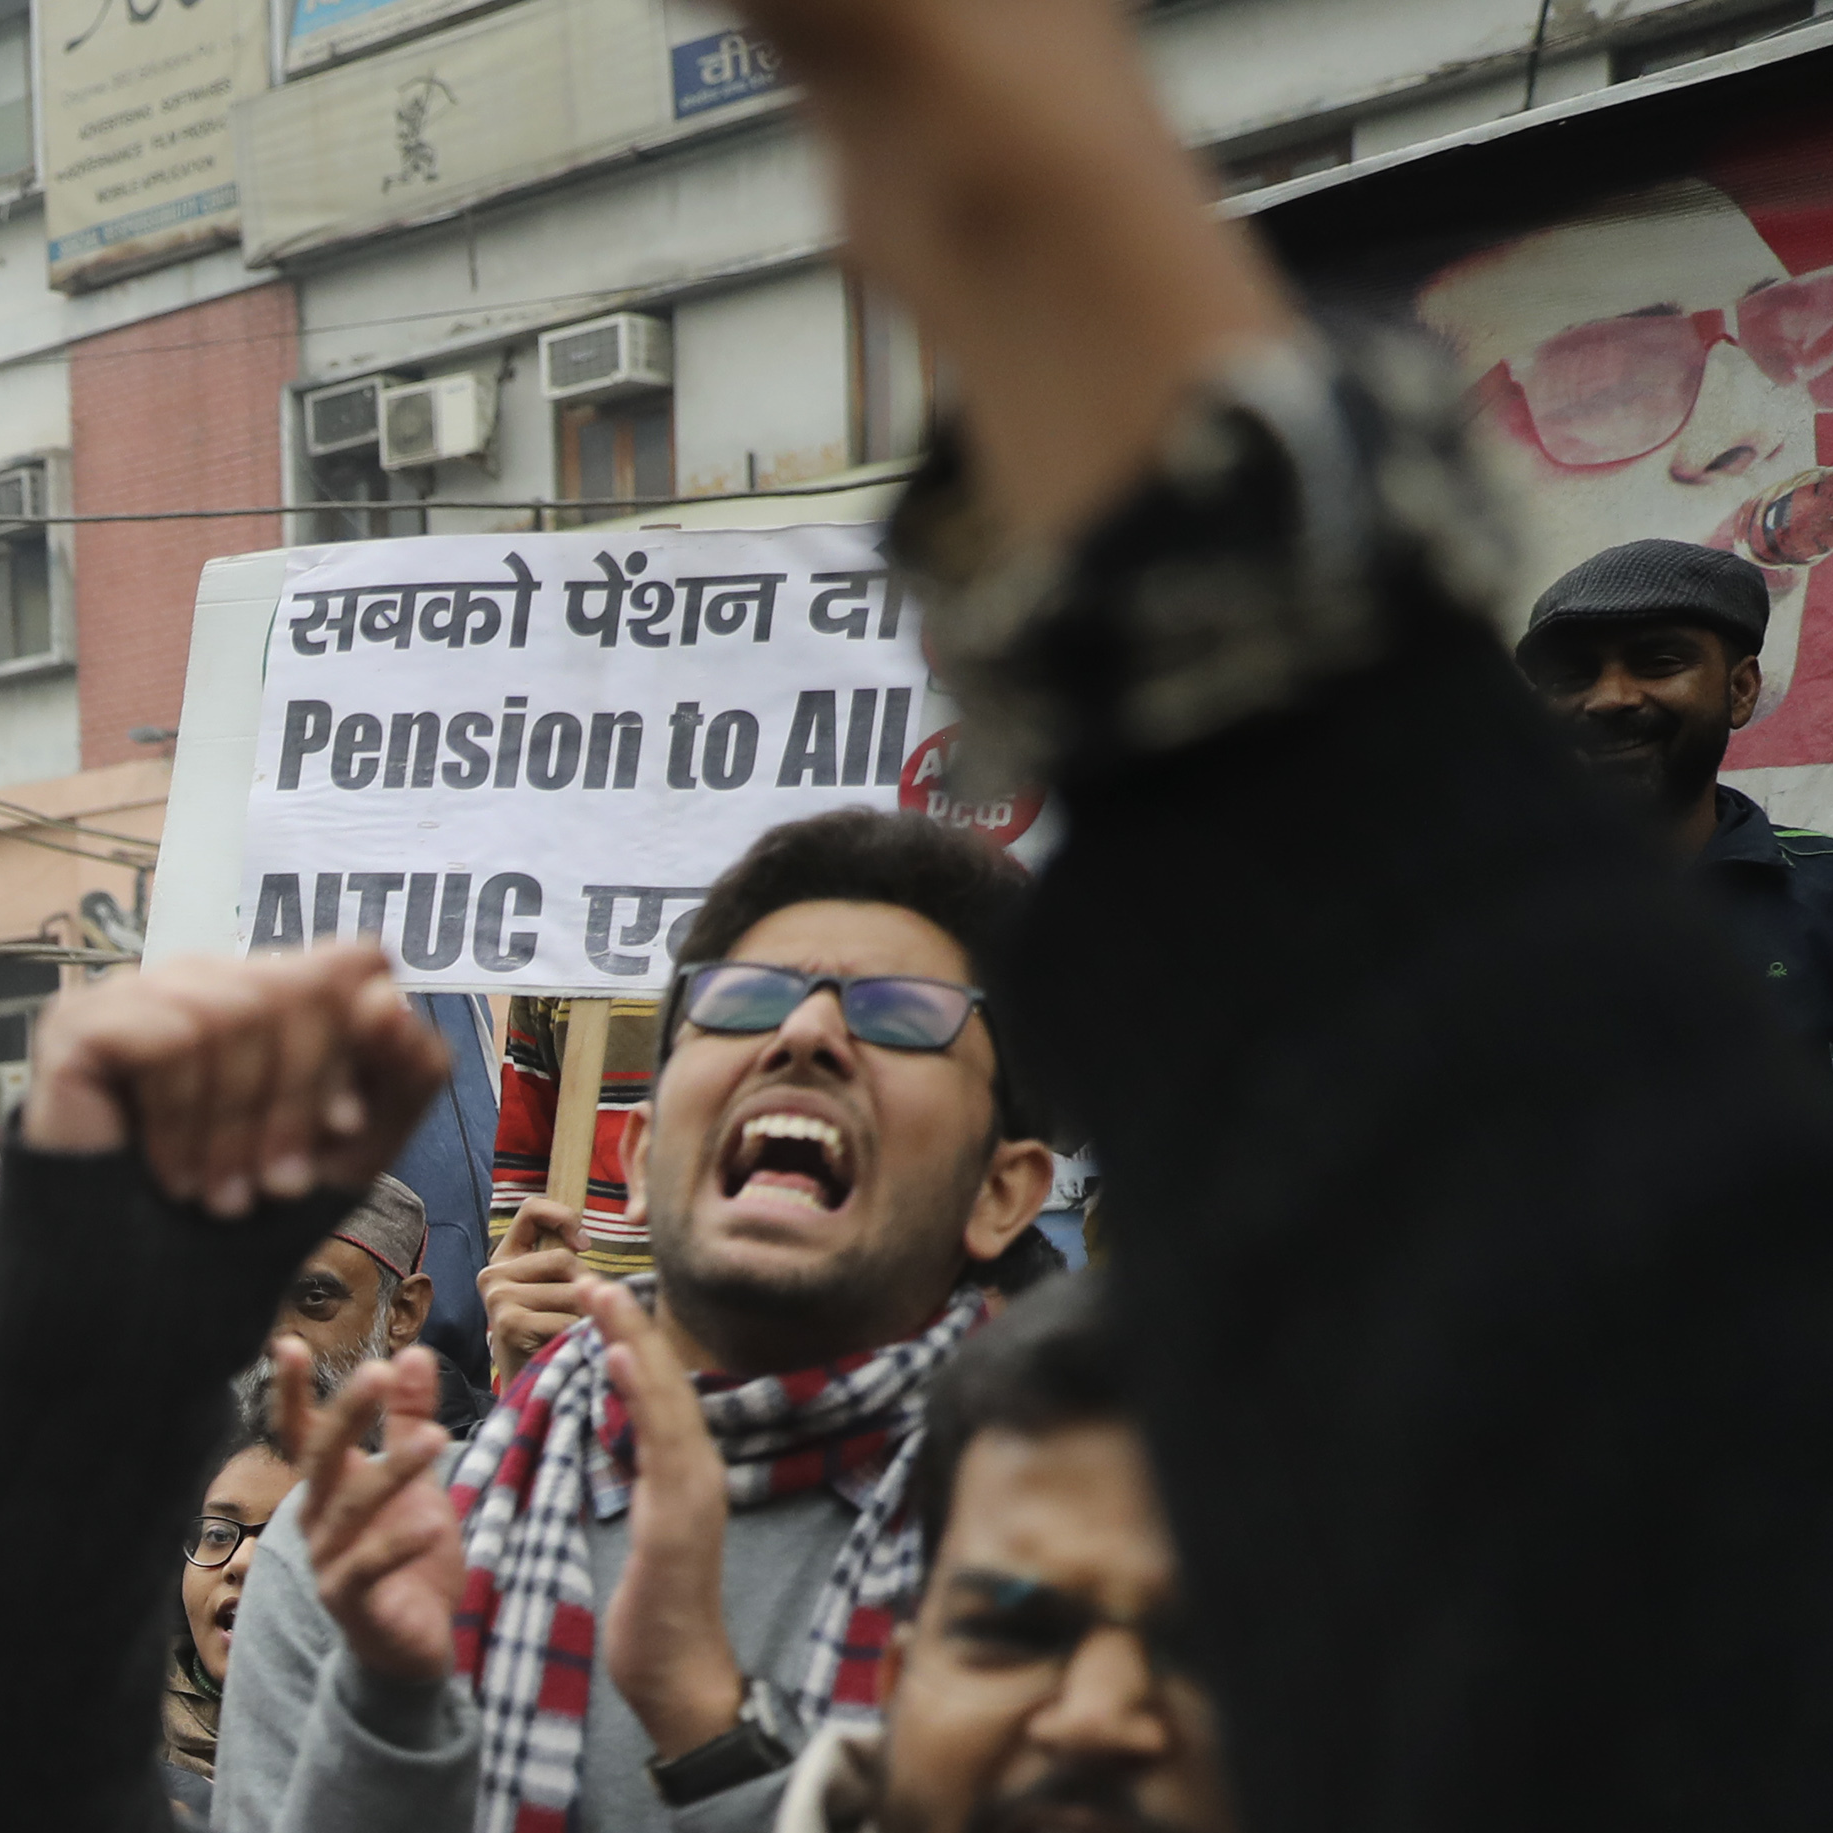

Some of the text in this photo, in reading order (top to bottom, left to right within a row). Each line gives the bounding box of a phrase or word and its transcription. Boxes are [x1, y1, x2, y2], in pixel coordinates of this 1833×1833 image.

[288, 551, 541, 657] सबको
[563, 550, 787, 649] पेंशन
[275, 695, 643, 792] Pension
[667, 700, 760, 791] to
[774, 686, 913, 789] All
[245, 871, 544, 974] AITUC
